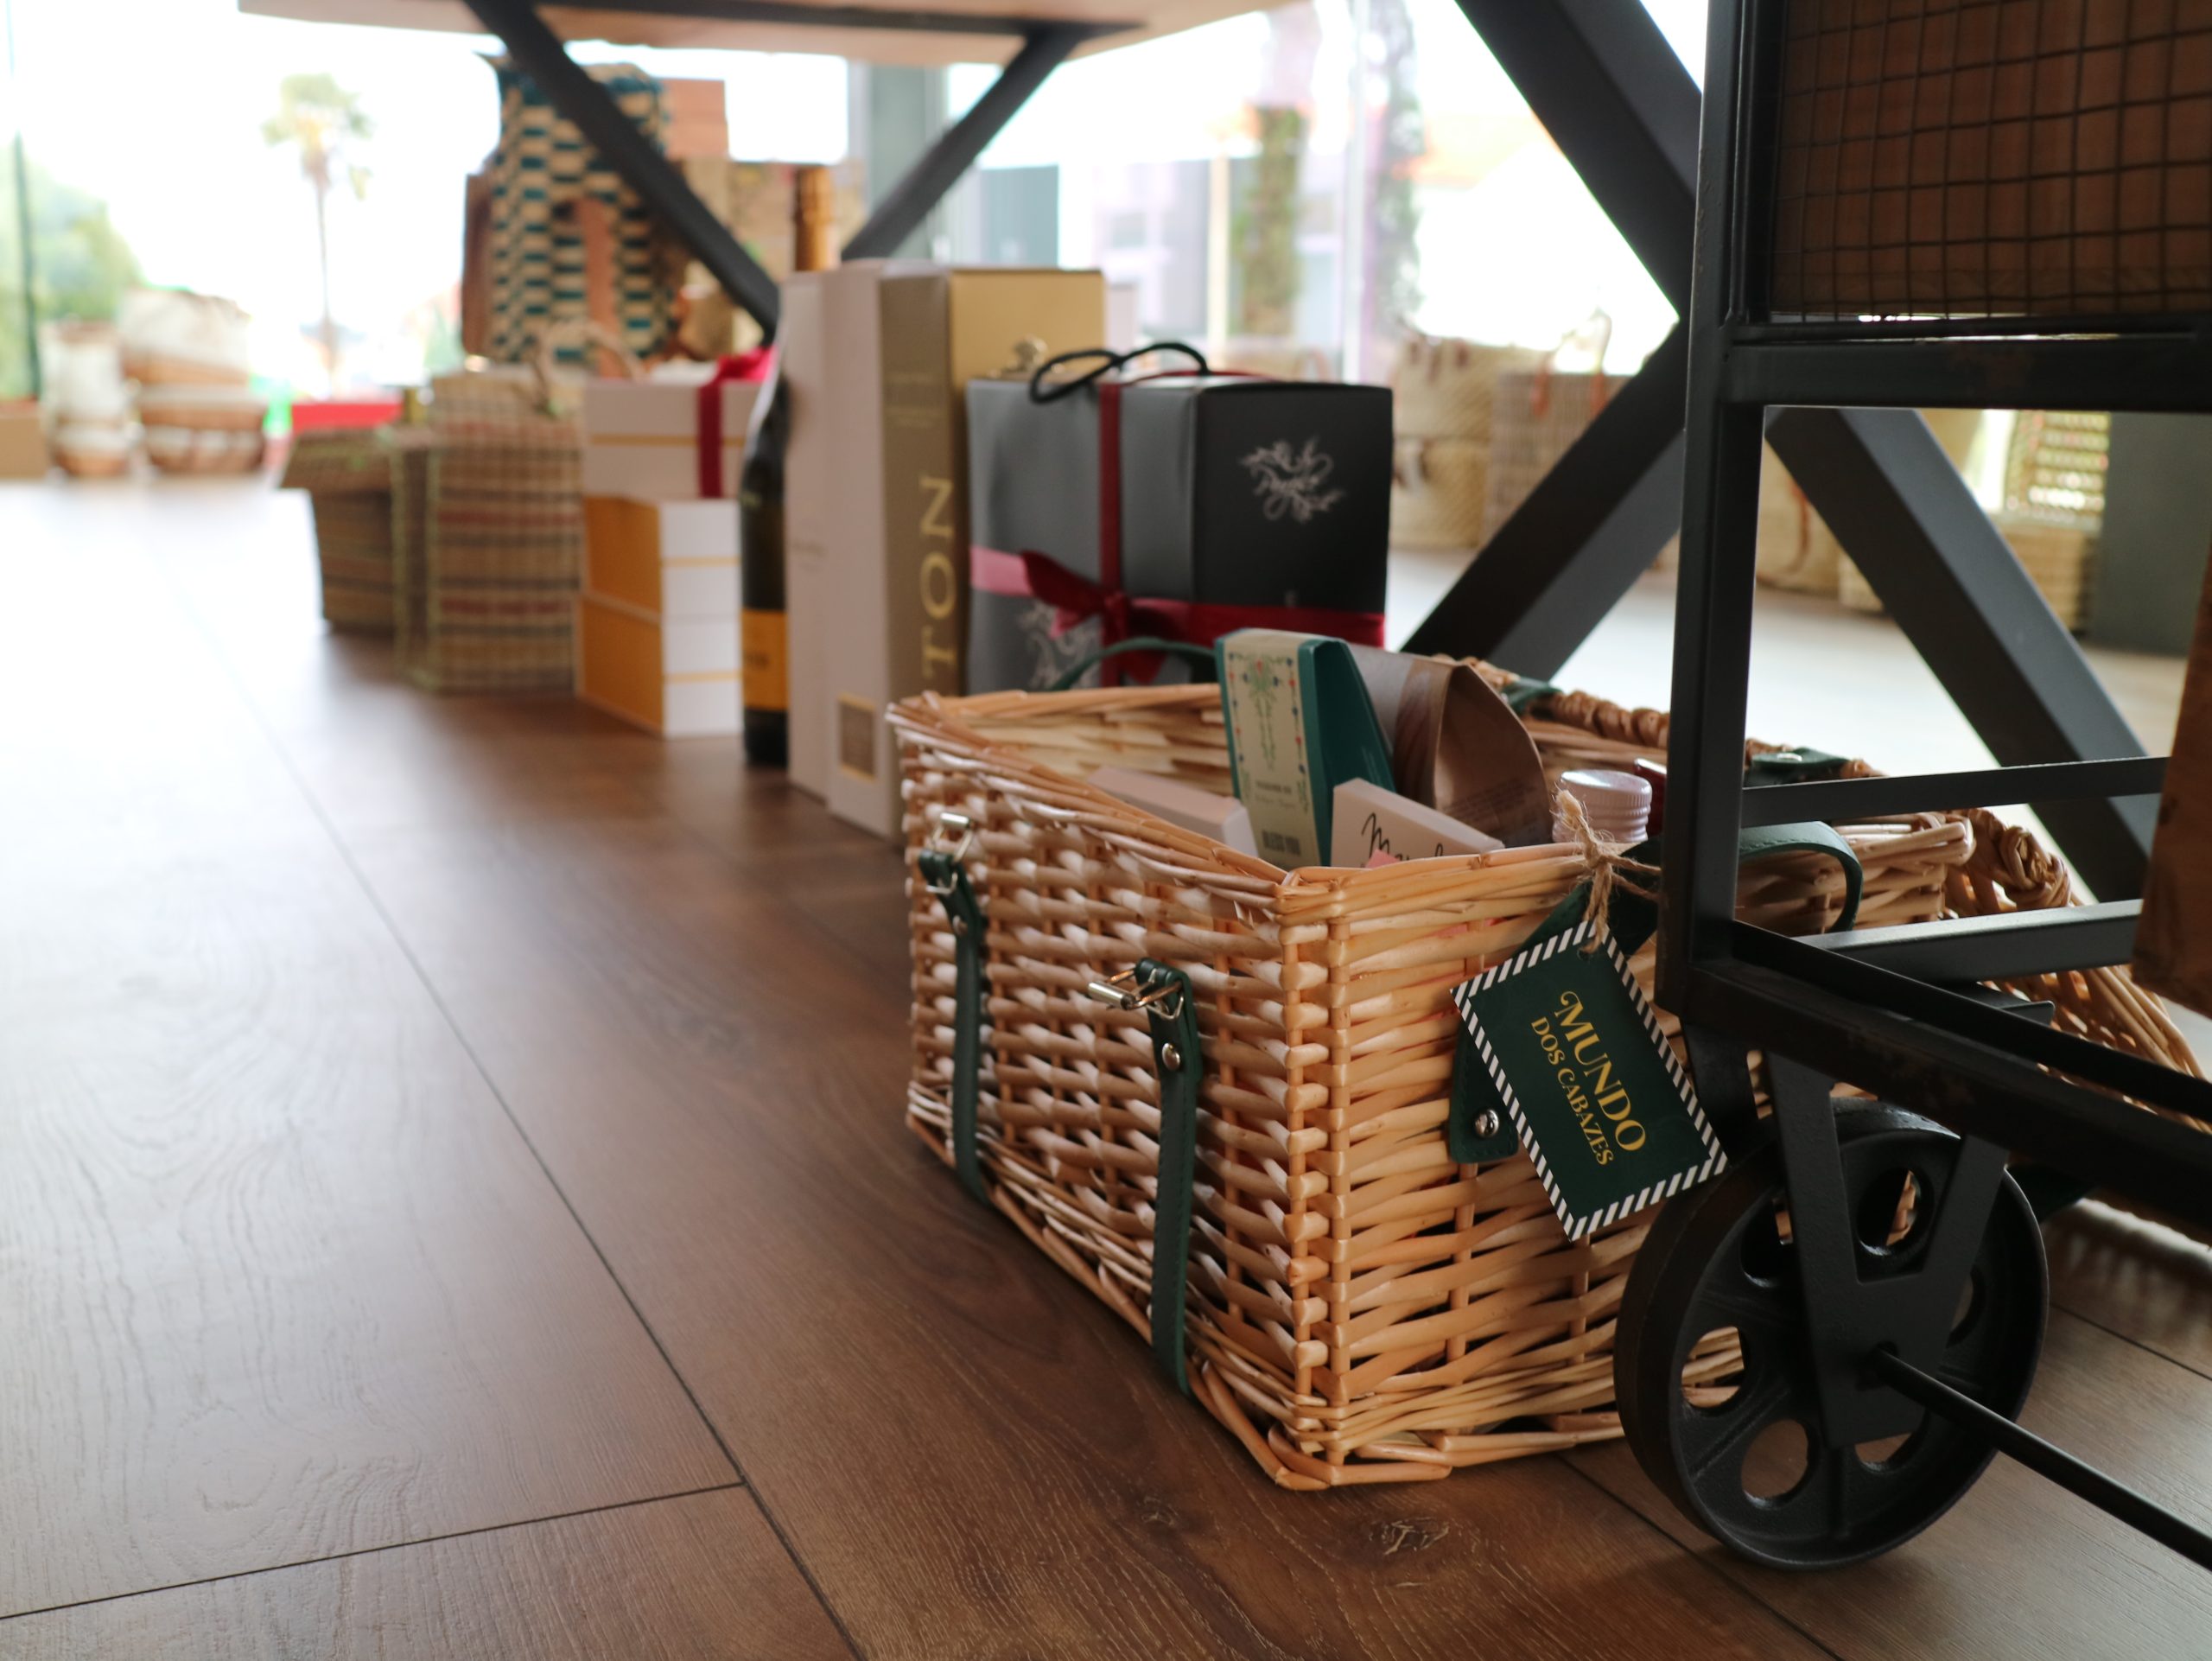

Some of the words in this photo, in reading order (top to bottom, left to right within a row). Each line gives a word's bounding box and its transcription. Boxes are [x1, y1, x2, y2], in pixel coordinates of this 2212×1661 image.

[1530, 1016, 1566, 1066] DOS
[1557, 1067, 1615, 1166] CABAZES
[1554, 990, 1647, 1152] MUNDO
